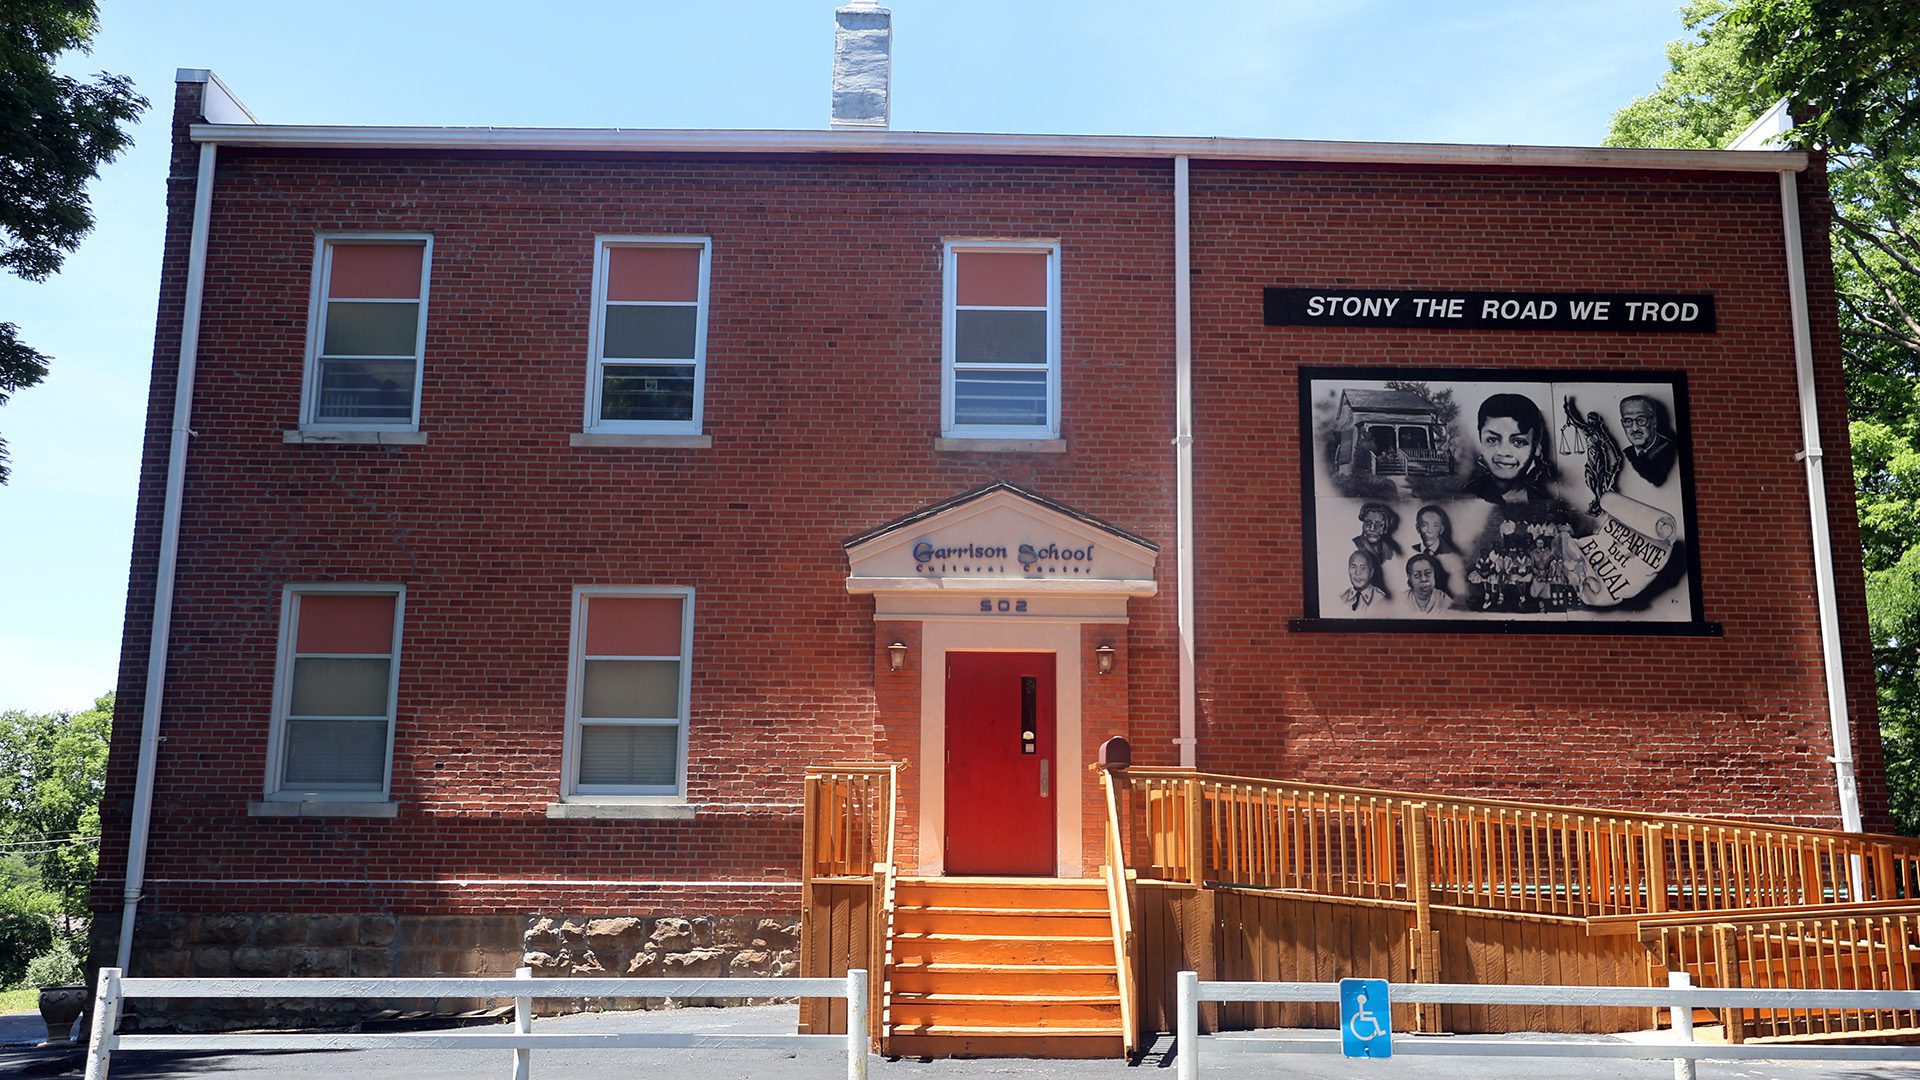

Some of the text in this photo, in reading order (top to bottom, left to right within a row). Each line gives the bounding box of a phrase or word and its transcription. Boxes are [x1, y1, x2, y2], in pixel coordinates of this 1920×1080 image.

[1306, 296, 1699, 322] STONY THE ROAD WE TROD
[913, 542, 1095, 564] Garrison School
[1603, 519, 1667, 569] SEPARATE
[1607, 540, 1630, 568] but
[1580, 539, 1631, 601] EQUAL
[980, 600, 1028, 612] 502
